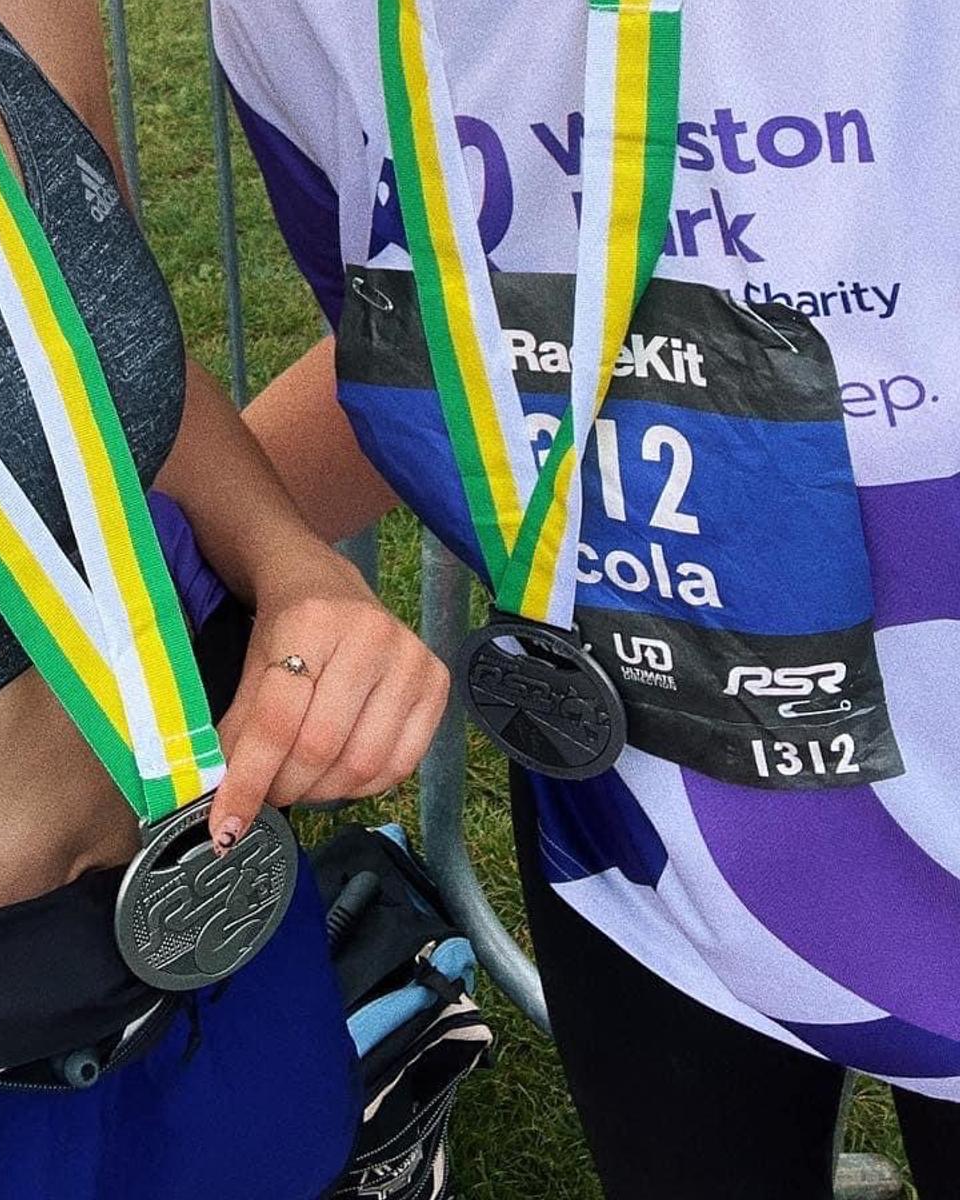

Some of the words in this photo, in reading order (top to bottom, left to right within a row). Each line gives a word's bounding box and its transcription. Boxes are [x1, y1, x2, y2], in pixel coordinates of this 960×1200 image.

[572, 187, 766, 264] rk
[500, 329, 708, 388] RaeKit
[840, 374, 940, 428] ep.
[576, 541, 725, 609] cola
[751, 732, 860, 778] 1312
